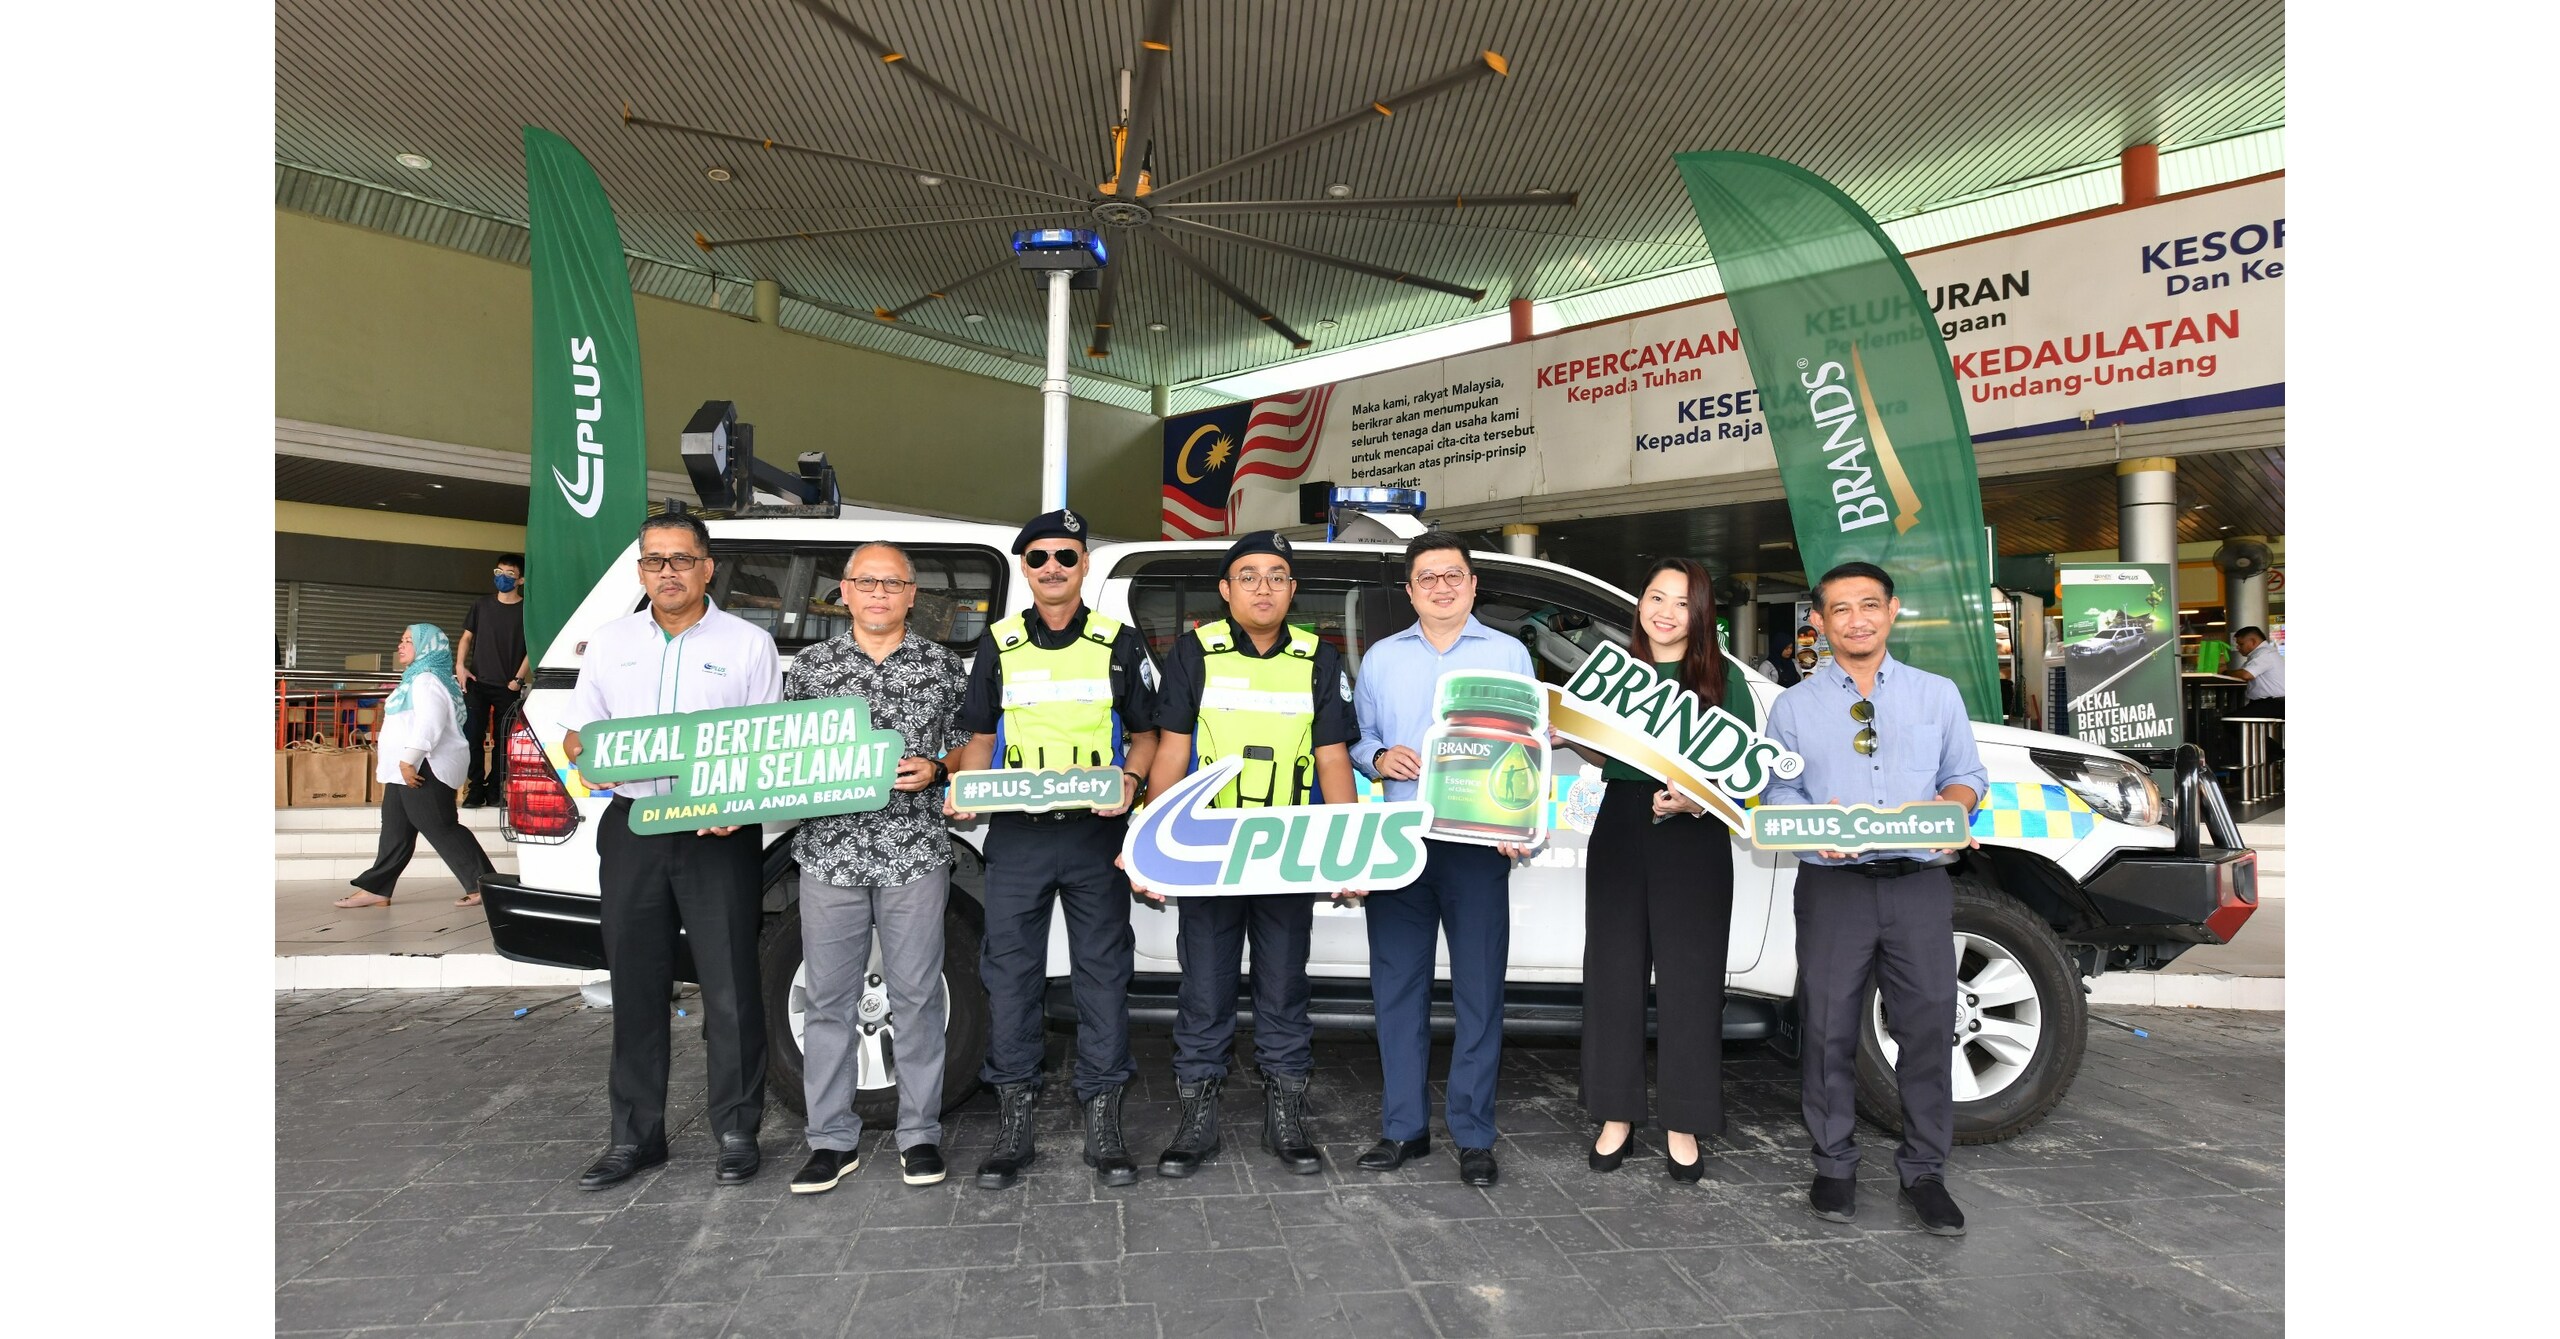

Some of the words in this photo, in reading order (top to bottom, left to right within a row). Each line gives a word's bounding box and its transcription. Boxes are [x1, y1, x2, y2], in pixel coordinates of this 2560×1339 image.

[2167, 272, 2230, 296] Dan
[1824, 310, 2007, 355] Perlembgaan
[1952, 308, 2240, 381] KEDAULATAN
[1536, 327, 1740, 389] KEPERCAYAAN
[571, 335, 604, 456] PLUS
[1352, 402, 1380, 415] Maka
[1383, 395, 1410, 410] kami,
[1413, 387, 1449, 407] rakyat
[1452, 377, 1504, 397] Malaysia,
[1567, 377, 1638, 404] Kepada
[1642, 365, 1702, 391] Tuhan
[1972, 352, 2218, 403] Undang-Undang
[1351, 432, 1389, 447] seluruh
[1392, 427, 1428, 441] tenaga
[1431, 421, 1451, 434] dan
[1455, 414, 1488, 429] usaha
[1490, 408, 1519, 423] kami
[1352, 416, 1393, 431] berikrar
[1395, 410, 1420, 424] akan
[1423, 395, 1499, 418] menumpukan
[1351, 448, 1381, 463] untuk
[1383, 439, 1434, 459] mencapai
[1437, 433, 1480, 450] cita-cita
[1483, 425, 1535, 441] tersebut
[1636, 420, 1711, 452] Kepada
[1717, 418, 1763, 442] Raja
[1351, 461, 1416, 480] berdasarkan
[1418, 457, 1441, 469] atas
[1443, 443, 1527, 468] prinsip-prinsip
[2076, 690, 2121, 712] KEKAL
[2077, 702, 2157, 730] BERTENAGA
[593, 724, 685, 769] KEKAL
[694, 707, 857, 758] BERTENAGA
[2078, 728, 2106, 745] DAN
[2110, 717, 2174, 743] SELAMAT
[689, 757, 749, 797] DAN
[756, 742, 890, 790] SELAMAT
[963, 776, 1113, 799] #PLUS_Safety
[642, 807, 662, 823] DI
[664, 803, 719, 822] MANA
[722, 799, 756, 814] JUA
[763, 793, 809, 811] ANDA
[812, 785, 877, 805] BERADA
[1764, 814, 1956, 839] #PLUS_Comfort
[1222, 811, 1423, 885] PLUS
